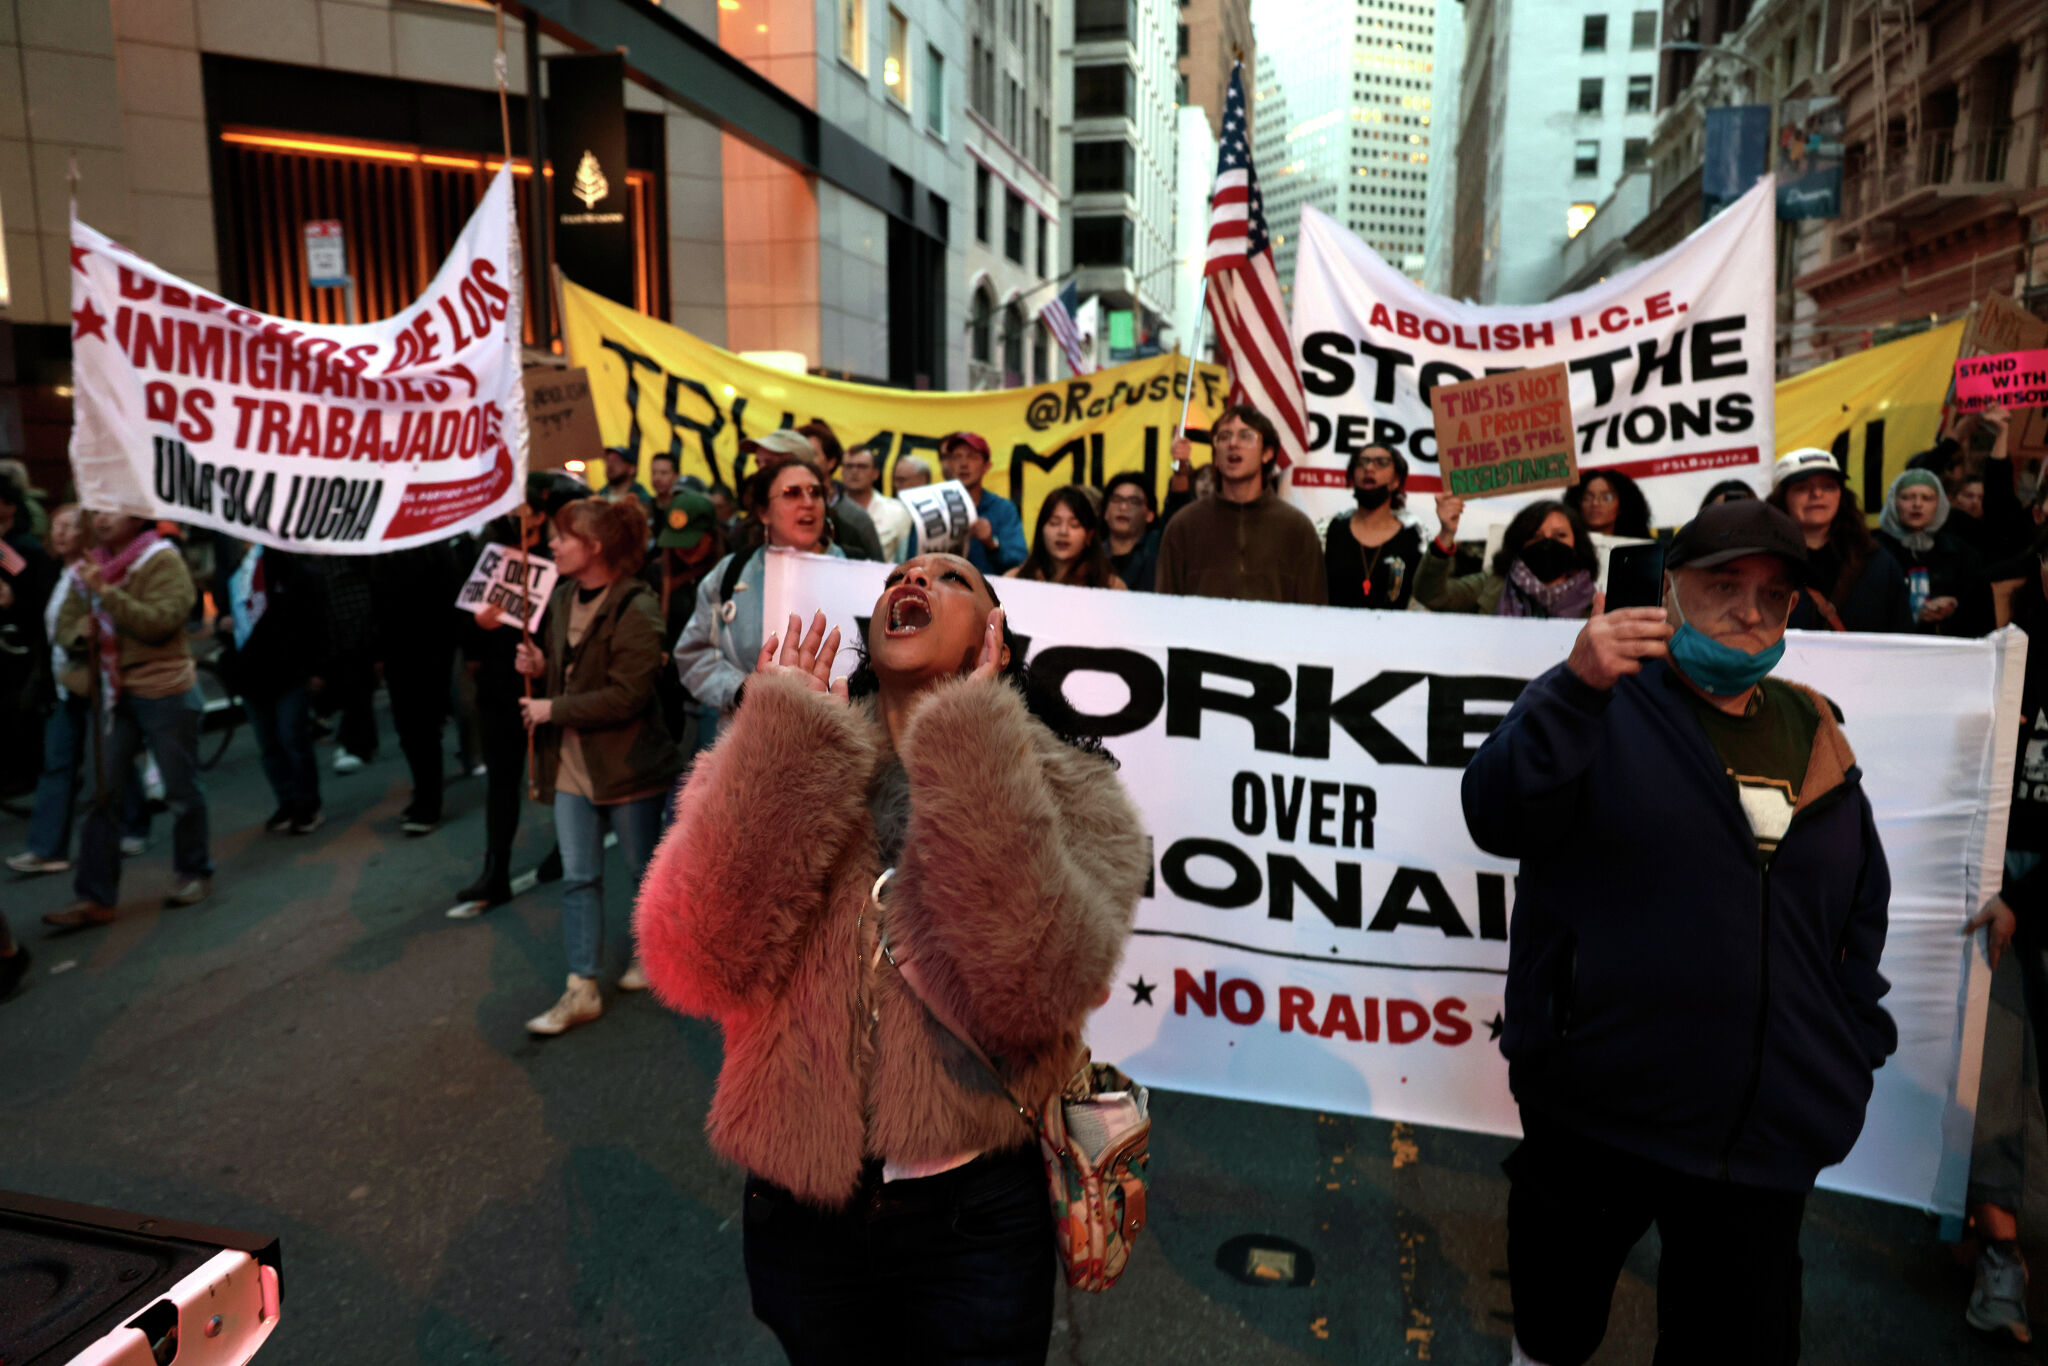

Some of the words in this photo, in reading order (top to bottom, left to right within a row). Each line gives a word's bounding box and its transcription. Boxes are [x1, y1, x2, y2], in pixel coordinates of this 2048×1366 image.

[381, 309, 441, 376] DE
[437, 258, 510, 354] LOS
[1369, 303, 1554, 350] ABOLISH
[1571, 292, 1687, 341] I.C.E.
[1301, 331, 1526, 411] STO
[1569, 315, 1749, 407] THE
[1960, 359, 2017, 377] STAND
[1992, 371, 2047, 389] WITH
[1440, 385, 1494, 417] THIS
[1496, 383, 1514, 407] IS
[1518, 372, 1561, 401] NOT
[1458, 420, 1472, 443] A
[1480, 400, 1564, 438] PROTEST
[1308, 393, 1754, 463] DEPOTIONS
[1448, 441, 1500, 467] THIS
[1502, 435, 1522, 456] IS
[1524, 427, 1566, 450] THE
[1450, 452, 1570, 495] RESISTANCE
[279, 475, 383, 540] LUCHA
[1231, 771, 1377, 849] OVER
[1174, 968, 1265, 1026] NO
[1278, 985, 1473, 1047] RAIDS
